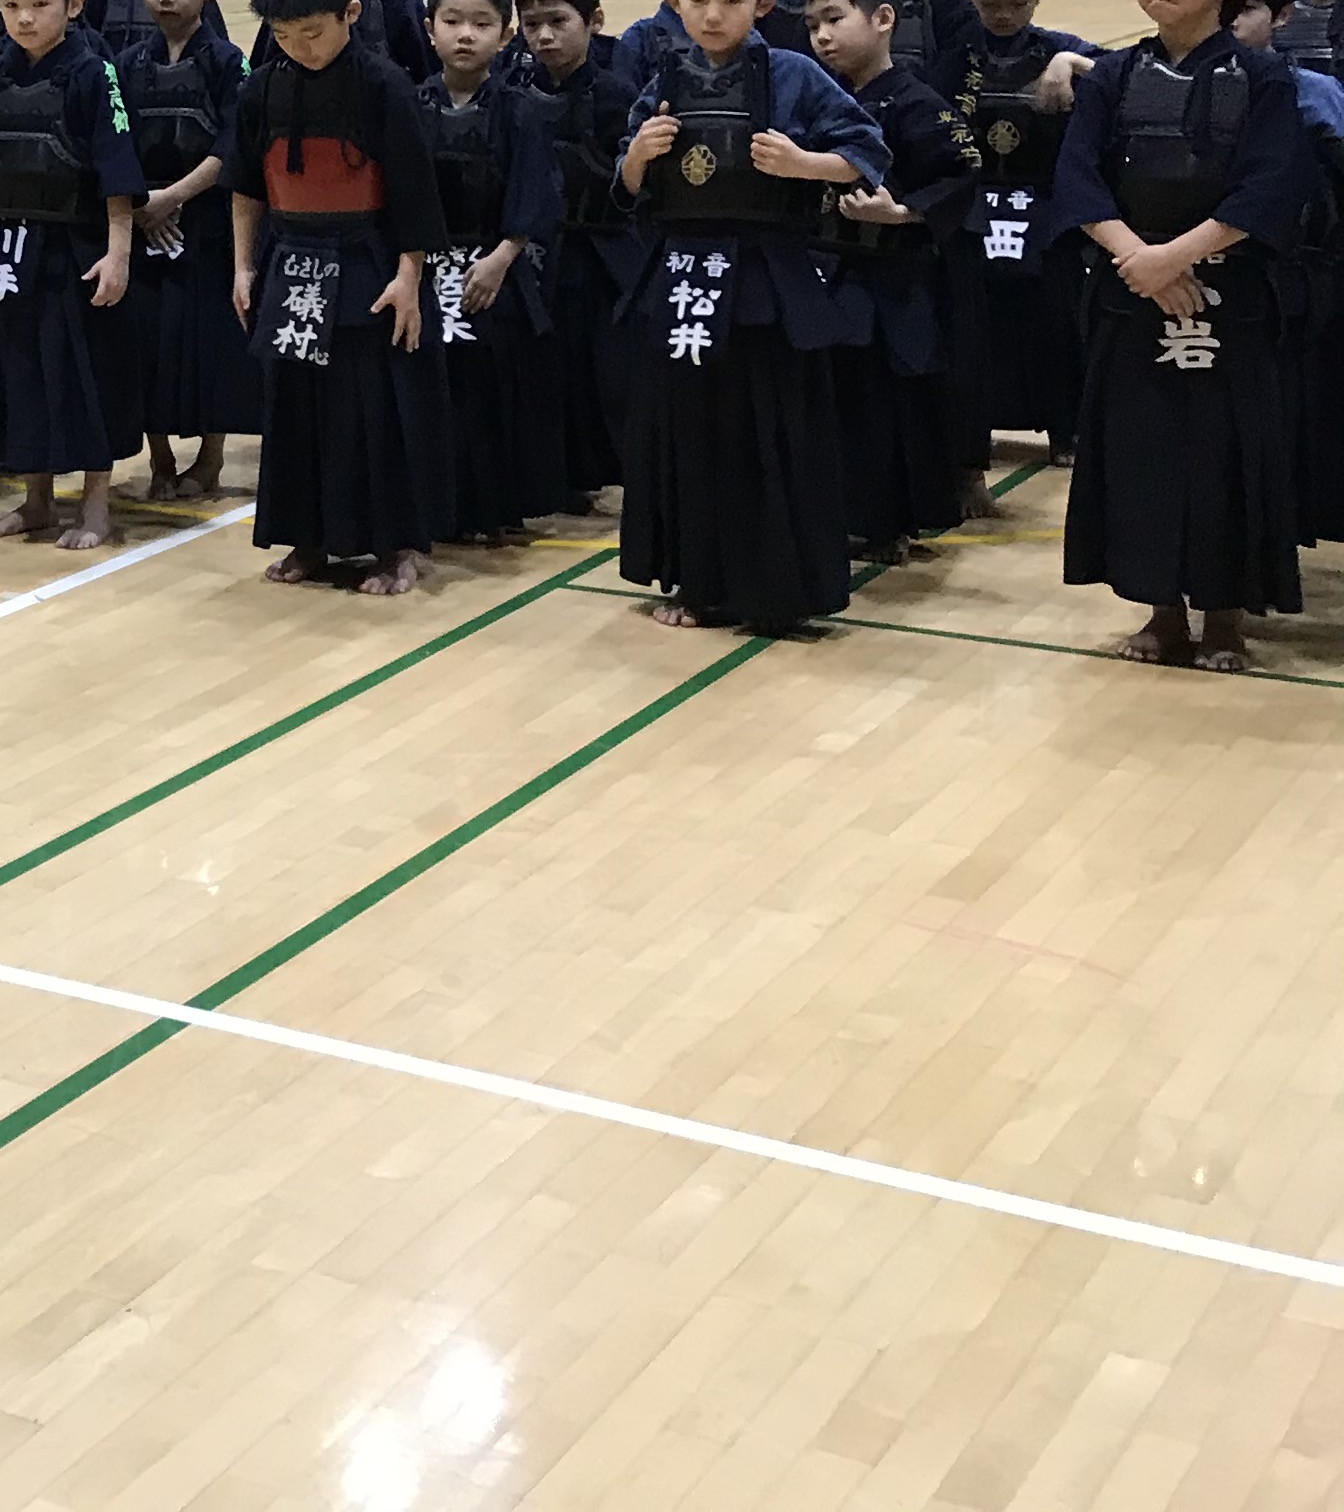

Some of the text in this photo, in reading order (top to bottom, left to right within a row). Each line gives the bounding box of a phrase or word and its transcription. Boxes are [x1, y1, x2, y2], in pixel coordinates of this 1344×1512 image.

[283, 253, 340, 279] むさしの
[666, 251, 732, 278] 初音
[668, 280, 723, 366] 松井
